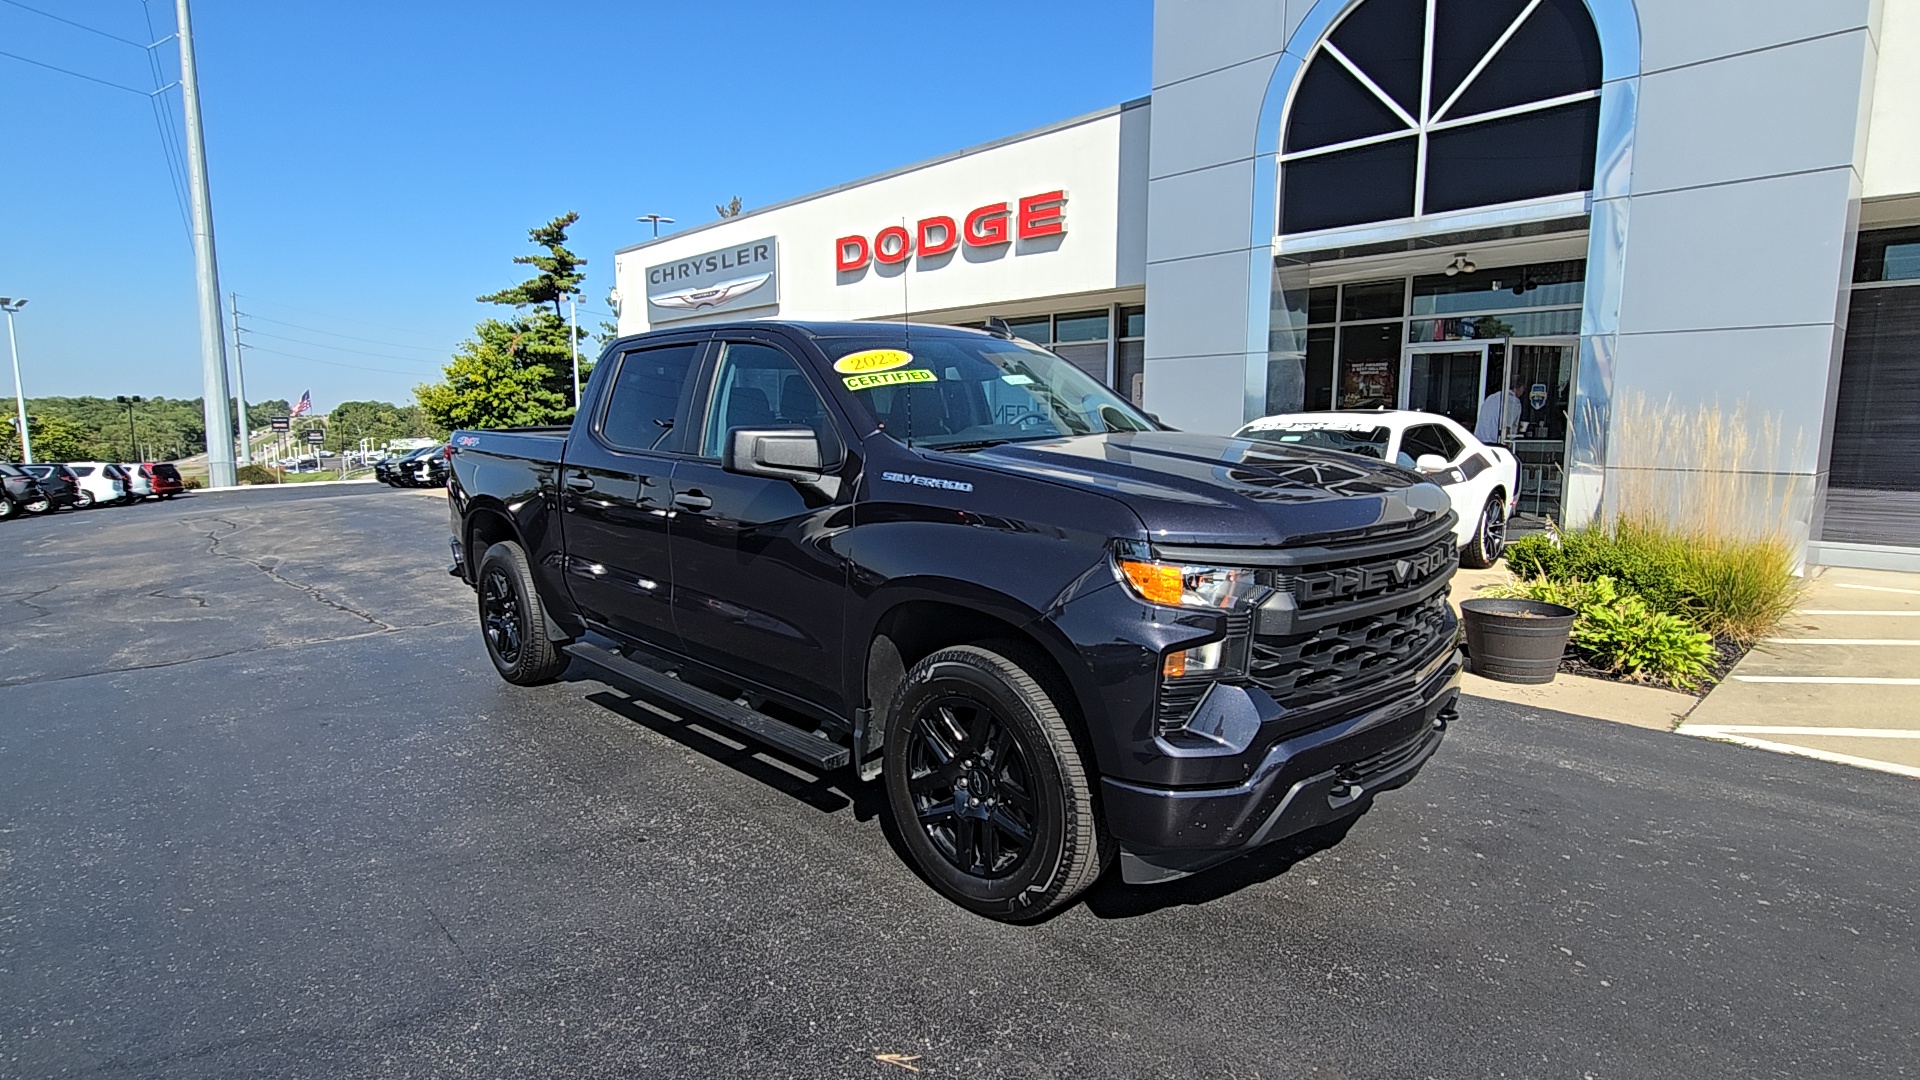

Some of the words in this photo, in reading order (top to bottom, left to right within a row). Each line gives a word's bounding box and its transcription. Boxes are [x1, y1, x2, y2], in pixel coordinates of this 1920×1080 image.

[836, 189, 1067, 272] DODGE
[650, 244, 768, 285] CHRYSLER
[850, 353, 899, 371] 2023
[847, 371, 931, 388] CERTIFIED
[881, 471, 974, 493] SILVERADO
[1296, 533, 1459, 601] CHEVROLE
